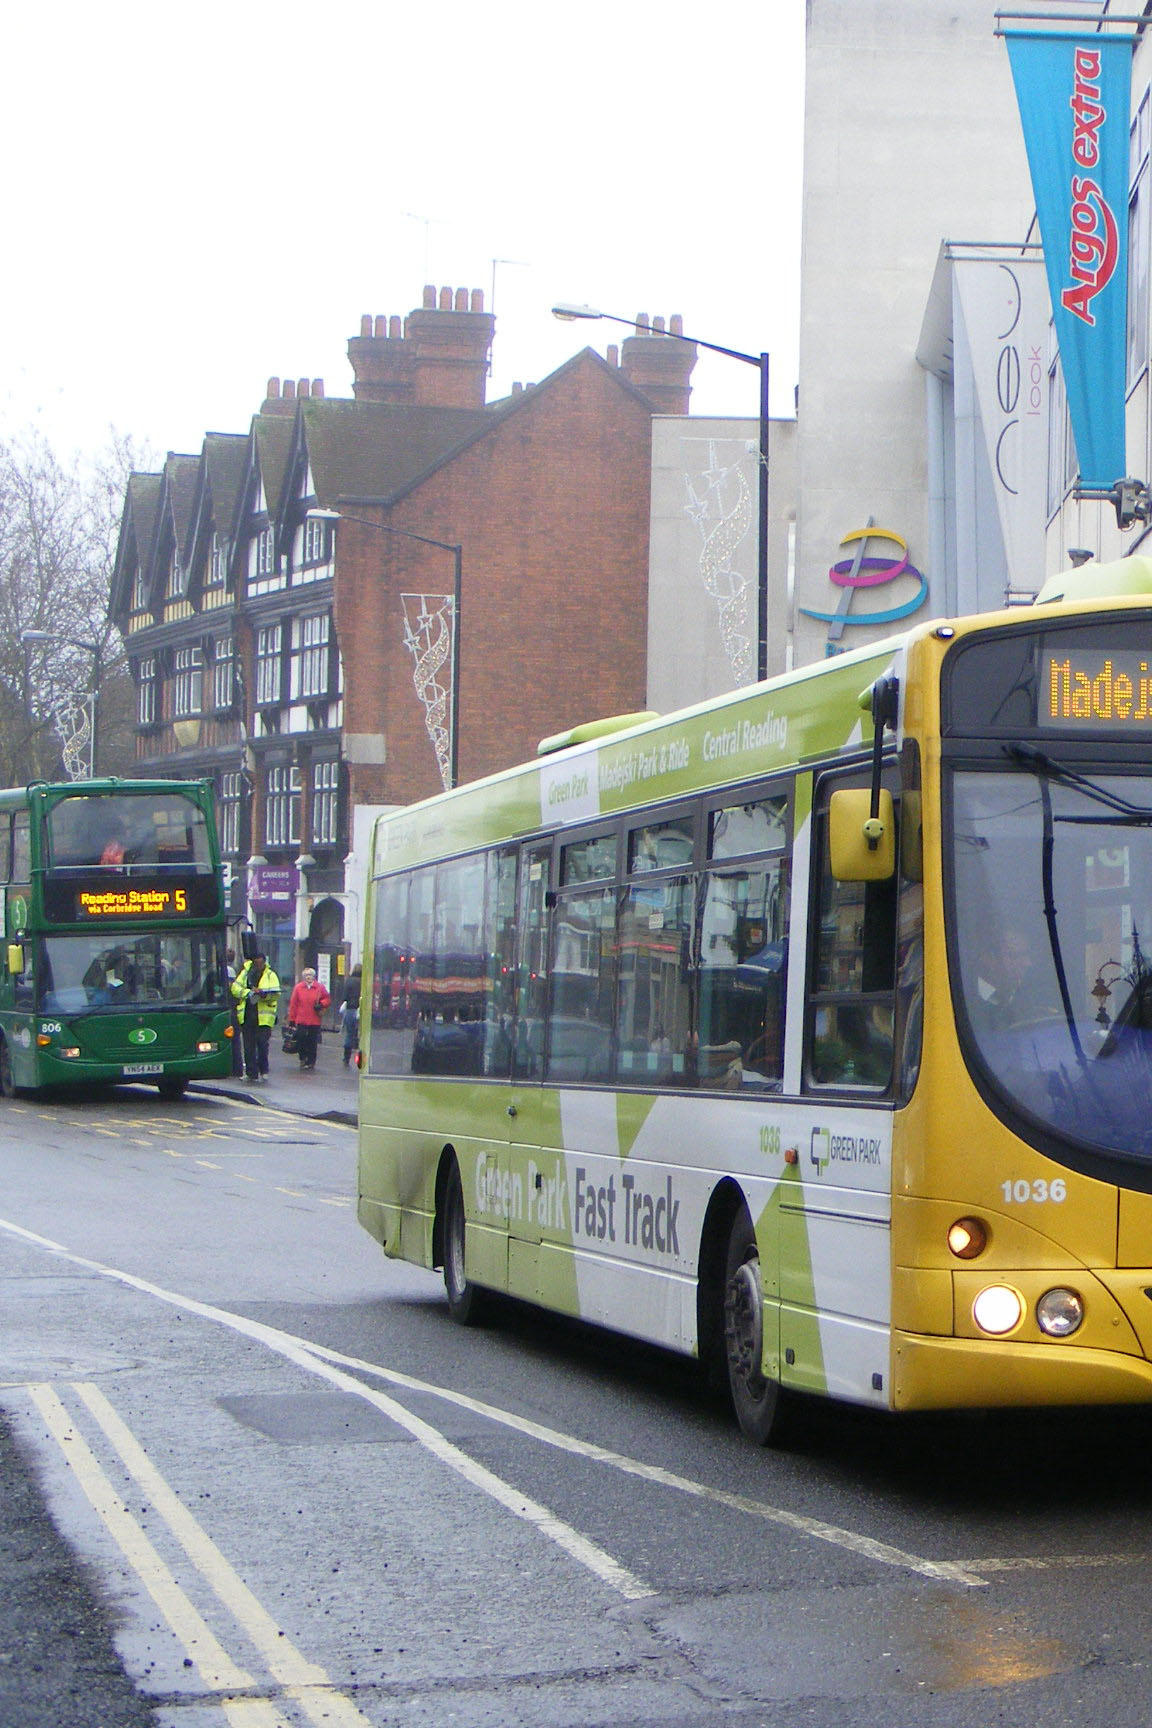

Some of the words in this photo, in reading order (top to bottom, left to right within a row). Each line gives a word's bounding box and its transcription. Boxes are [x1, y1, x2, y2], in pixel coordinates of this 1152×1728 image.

[1070, 46, 1105, 168] extra
[1060, 175, 1118, 326] Argos
[1027, 345, 1042, 415] look
[702, 720, 741, 762] Central
[743, 711, 788, 750] Reading
[638, 749, 658, 779] Park
[659, 748, 668, 772] &
[669, 737, 689, 771] Ride
[81, 892, 127, 905] Reading
[128, 890, 170, 904] Station
[175, 889, 186, 911] 5
[41, 1022, 62, 1033] 806
[760, 1125, 781, 1154] 1036
[830, 1135, 857, 1162] GREEN
[859, 1138, 882, 1165] PARK
[475, 1151, 523, 1219] Green
[528, 1159, 566, 1230] Park
[575, 1167, 616, 1242] Fast
[622, 1173, 680, 1256] Track
[1002, 1179, 1067, 1203] 1036
